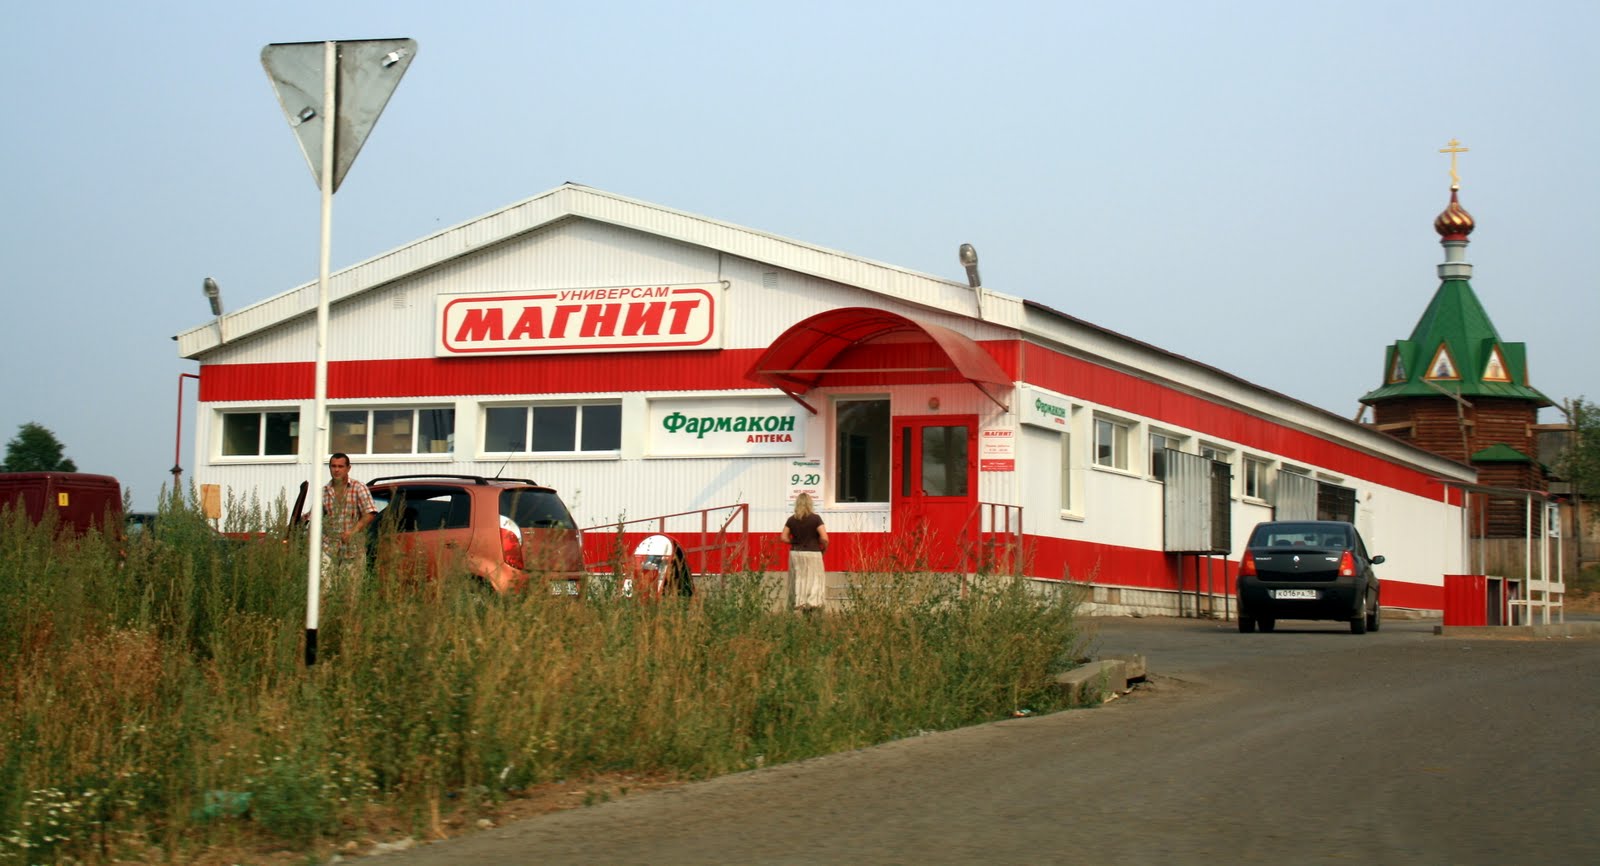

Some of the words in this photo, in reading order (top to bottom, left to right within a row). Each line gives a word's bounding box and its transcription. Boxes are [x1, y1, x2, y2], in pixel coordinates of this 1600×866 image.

[559, 286, 670, 302] УНИВЕРСАМ
[454, 299, 701, 342] МАГНИТ
[1035, 397, 1066, 418] Фармакон
[663, 412, 796, 438] Фармакон
[746, 434, 793, 443] АПТЕКА
[791, 474, 820, 485] 9-20
